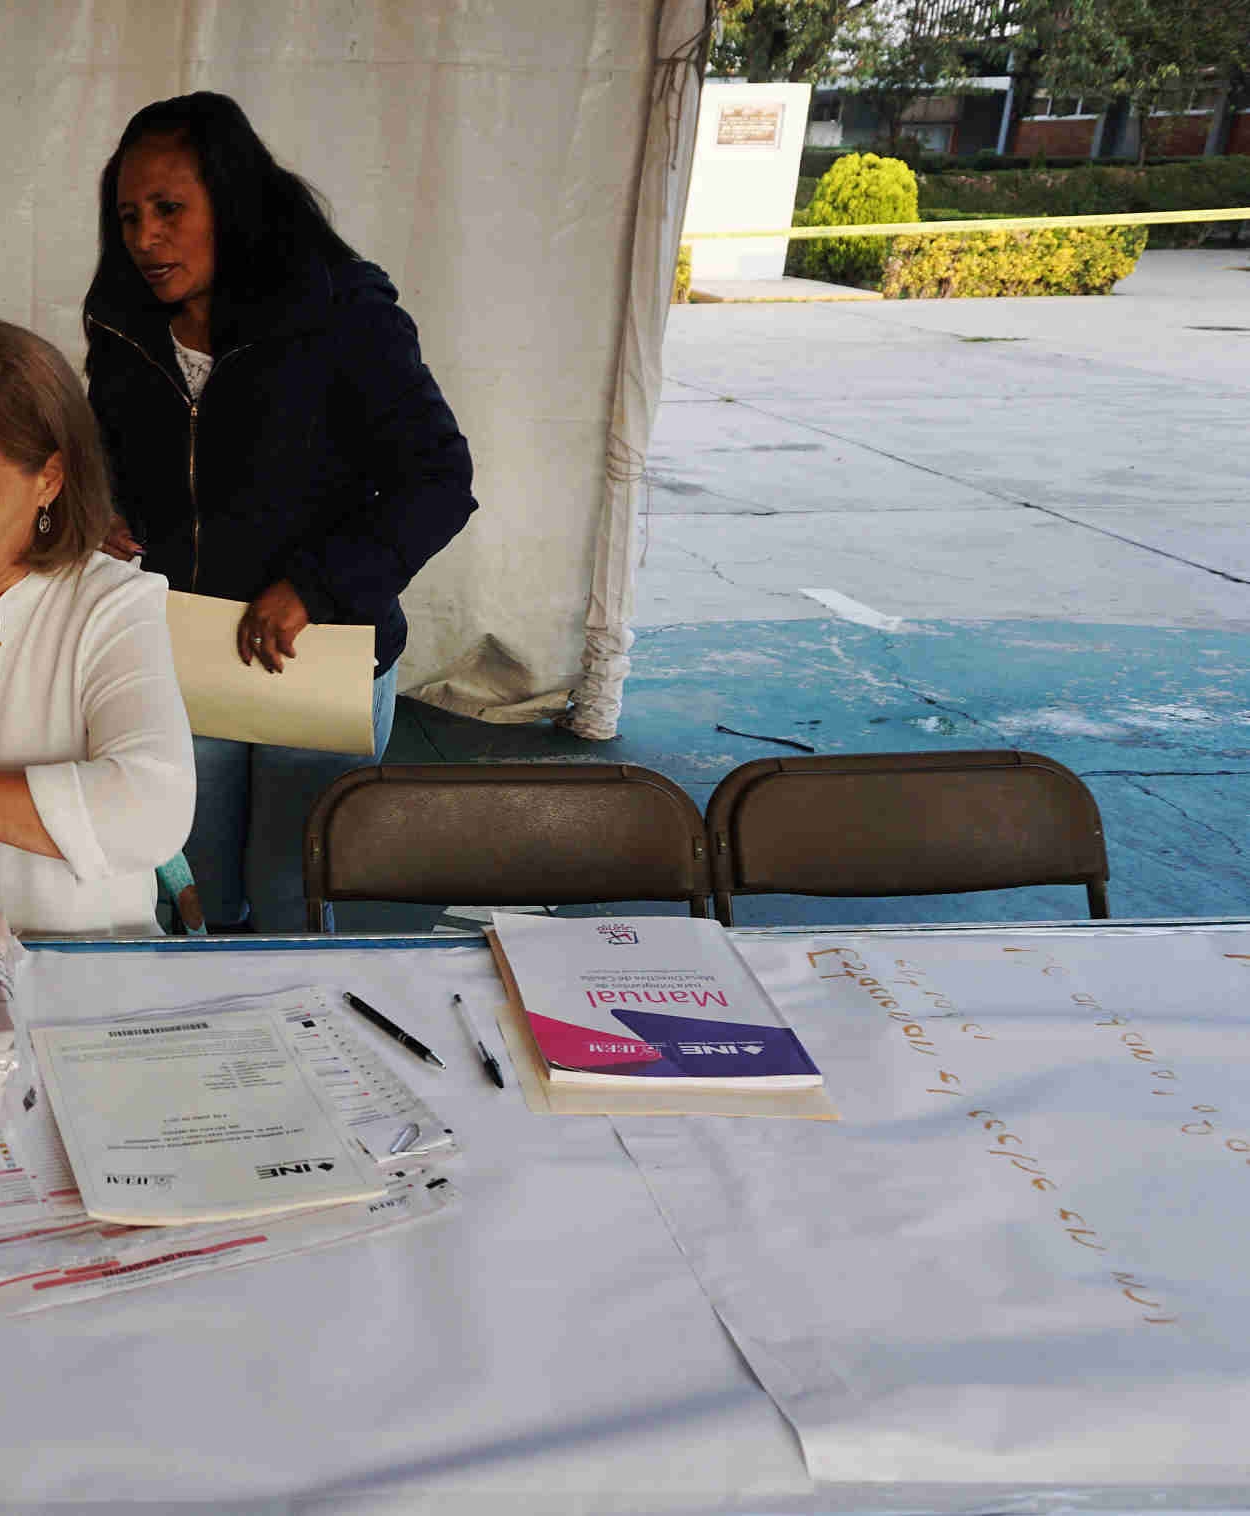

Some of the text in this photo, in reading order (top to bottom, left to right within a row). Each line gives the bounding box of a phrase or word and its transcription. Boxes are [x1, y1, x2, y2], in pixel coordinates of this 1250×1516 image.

[585, 989, 729, 1009] Manual
[589, 1043, 636, 1053] IEEM
[679, 1045, 739, 1055] INE
[257, 1164, 312, 1180] INE
